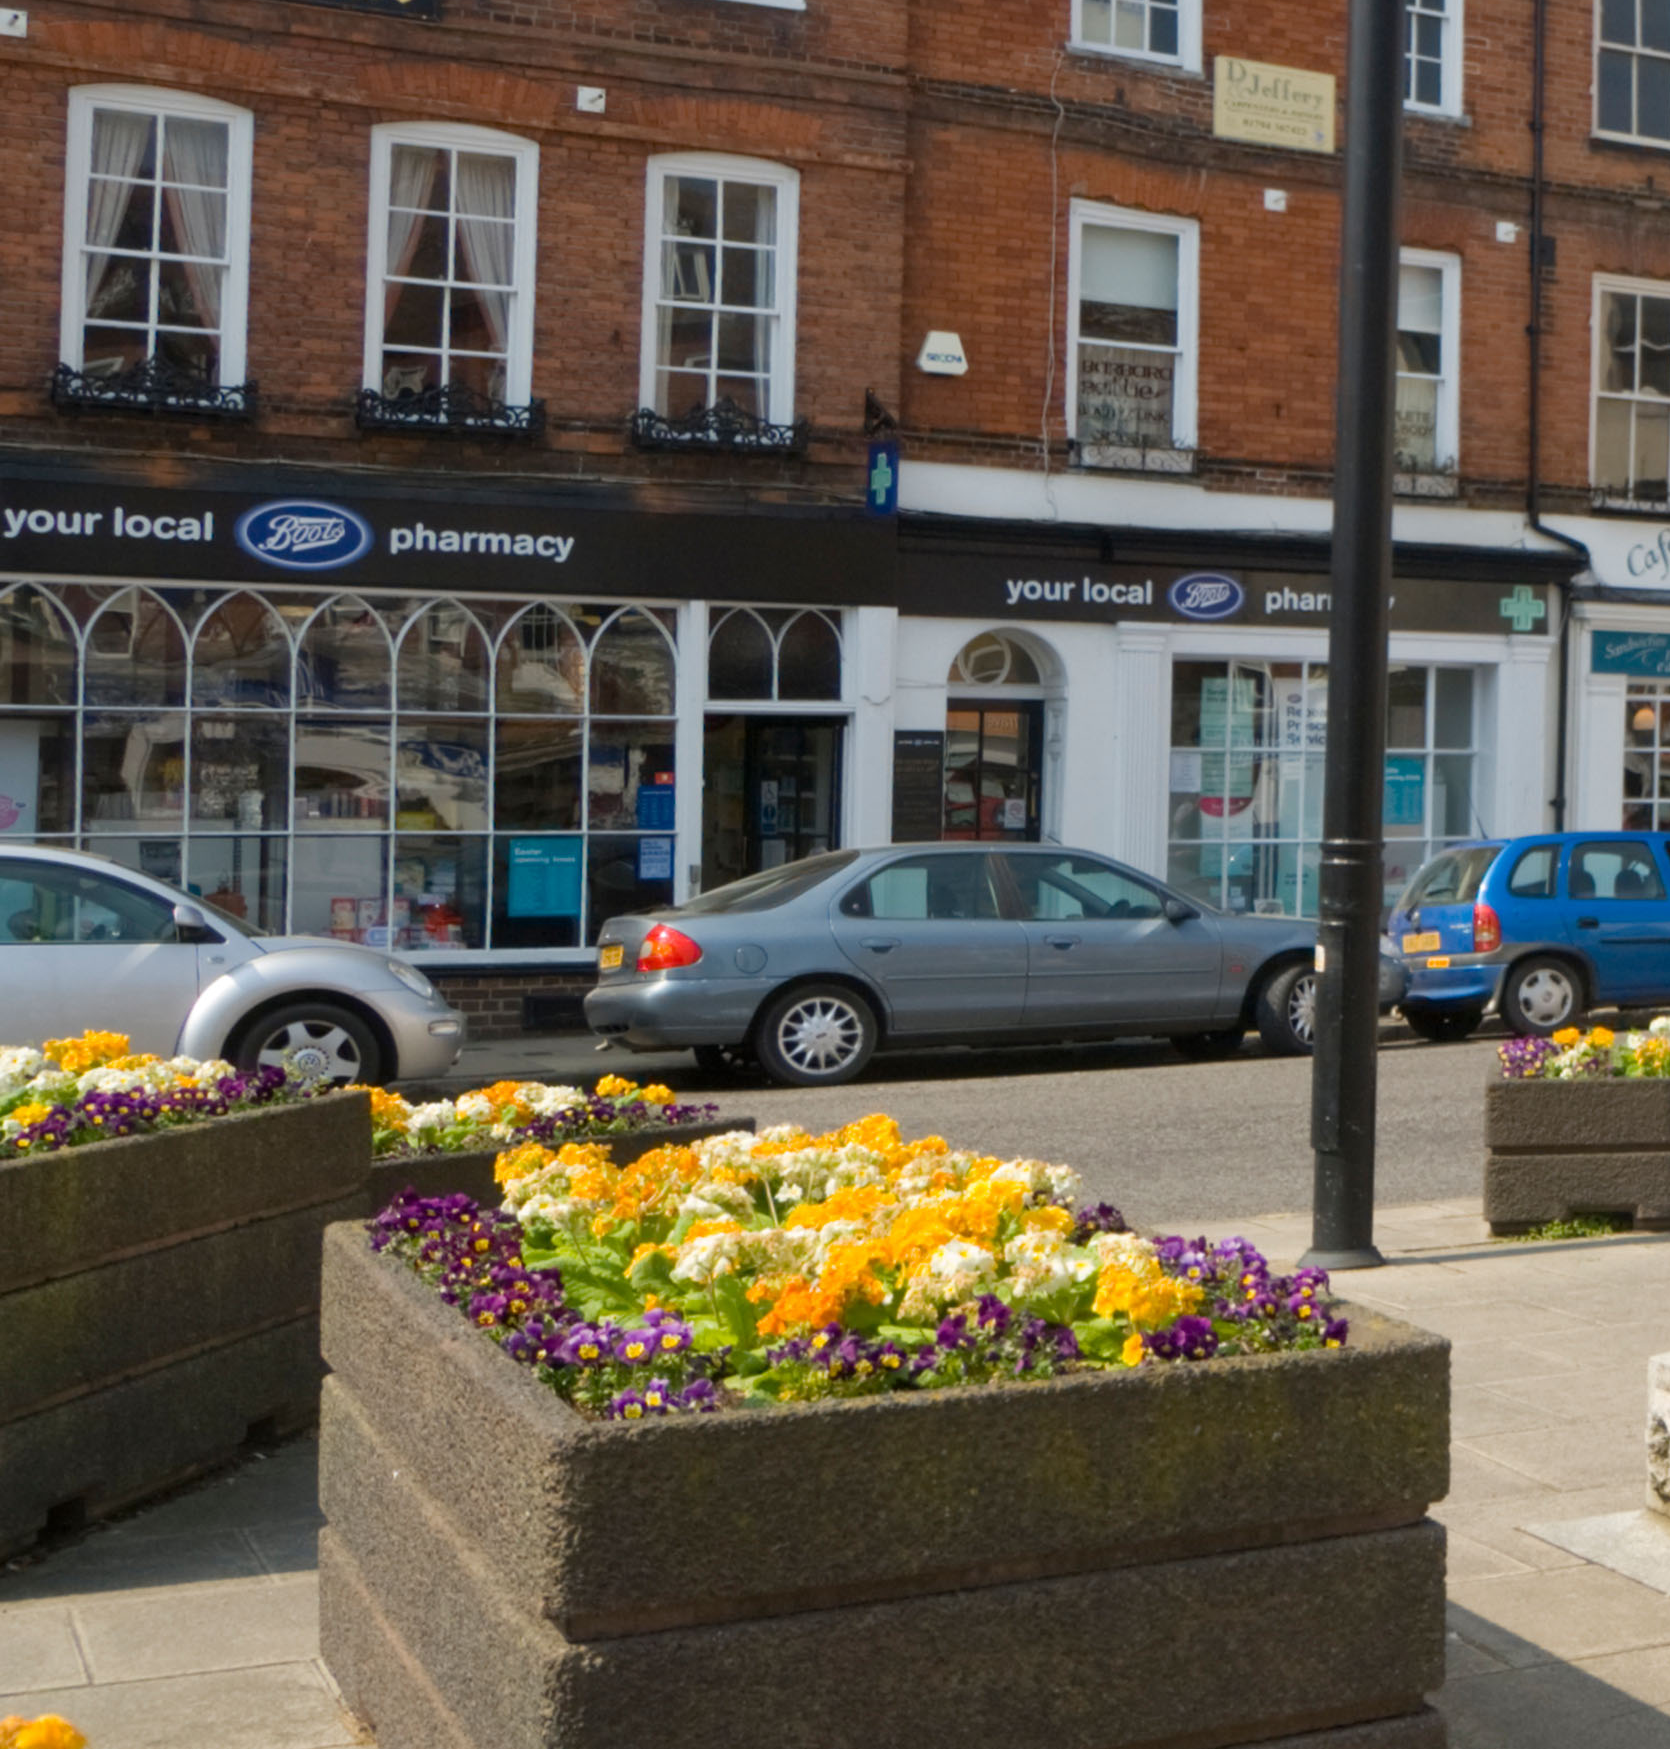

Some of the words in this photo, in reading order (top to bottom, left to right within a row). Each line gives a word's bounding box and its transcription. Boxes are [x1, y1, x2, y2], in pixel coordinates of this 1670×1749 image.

[4, 507, 103, 539] your
[113, 506, 214, 542] local
[258, 514, 346, 553] Boots
[390, 522, 576, 563] pharmacy
[1006, 578, 1075, 605] your
[1083, 577, 1153, 605] local
[1180, 582, 1231, 610] Boots
